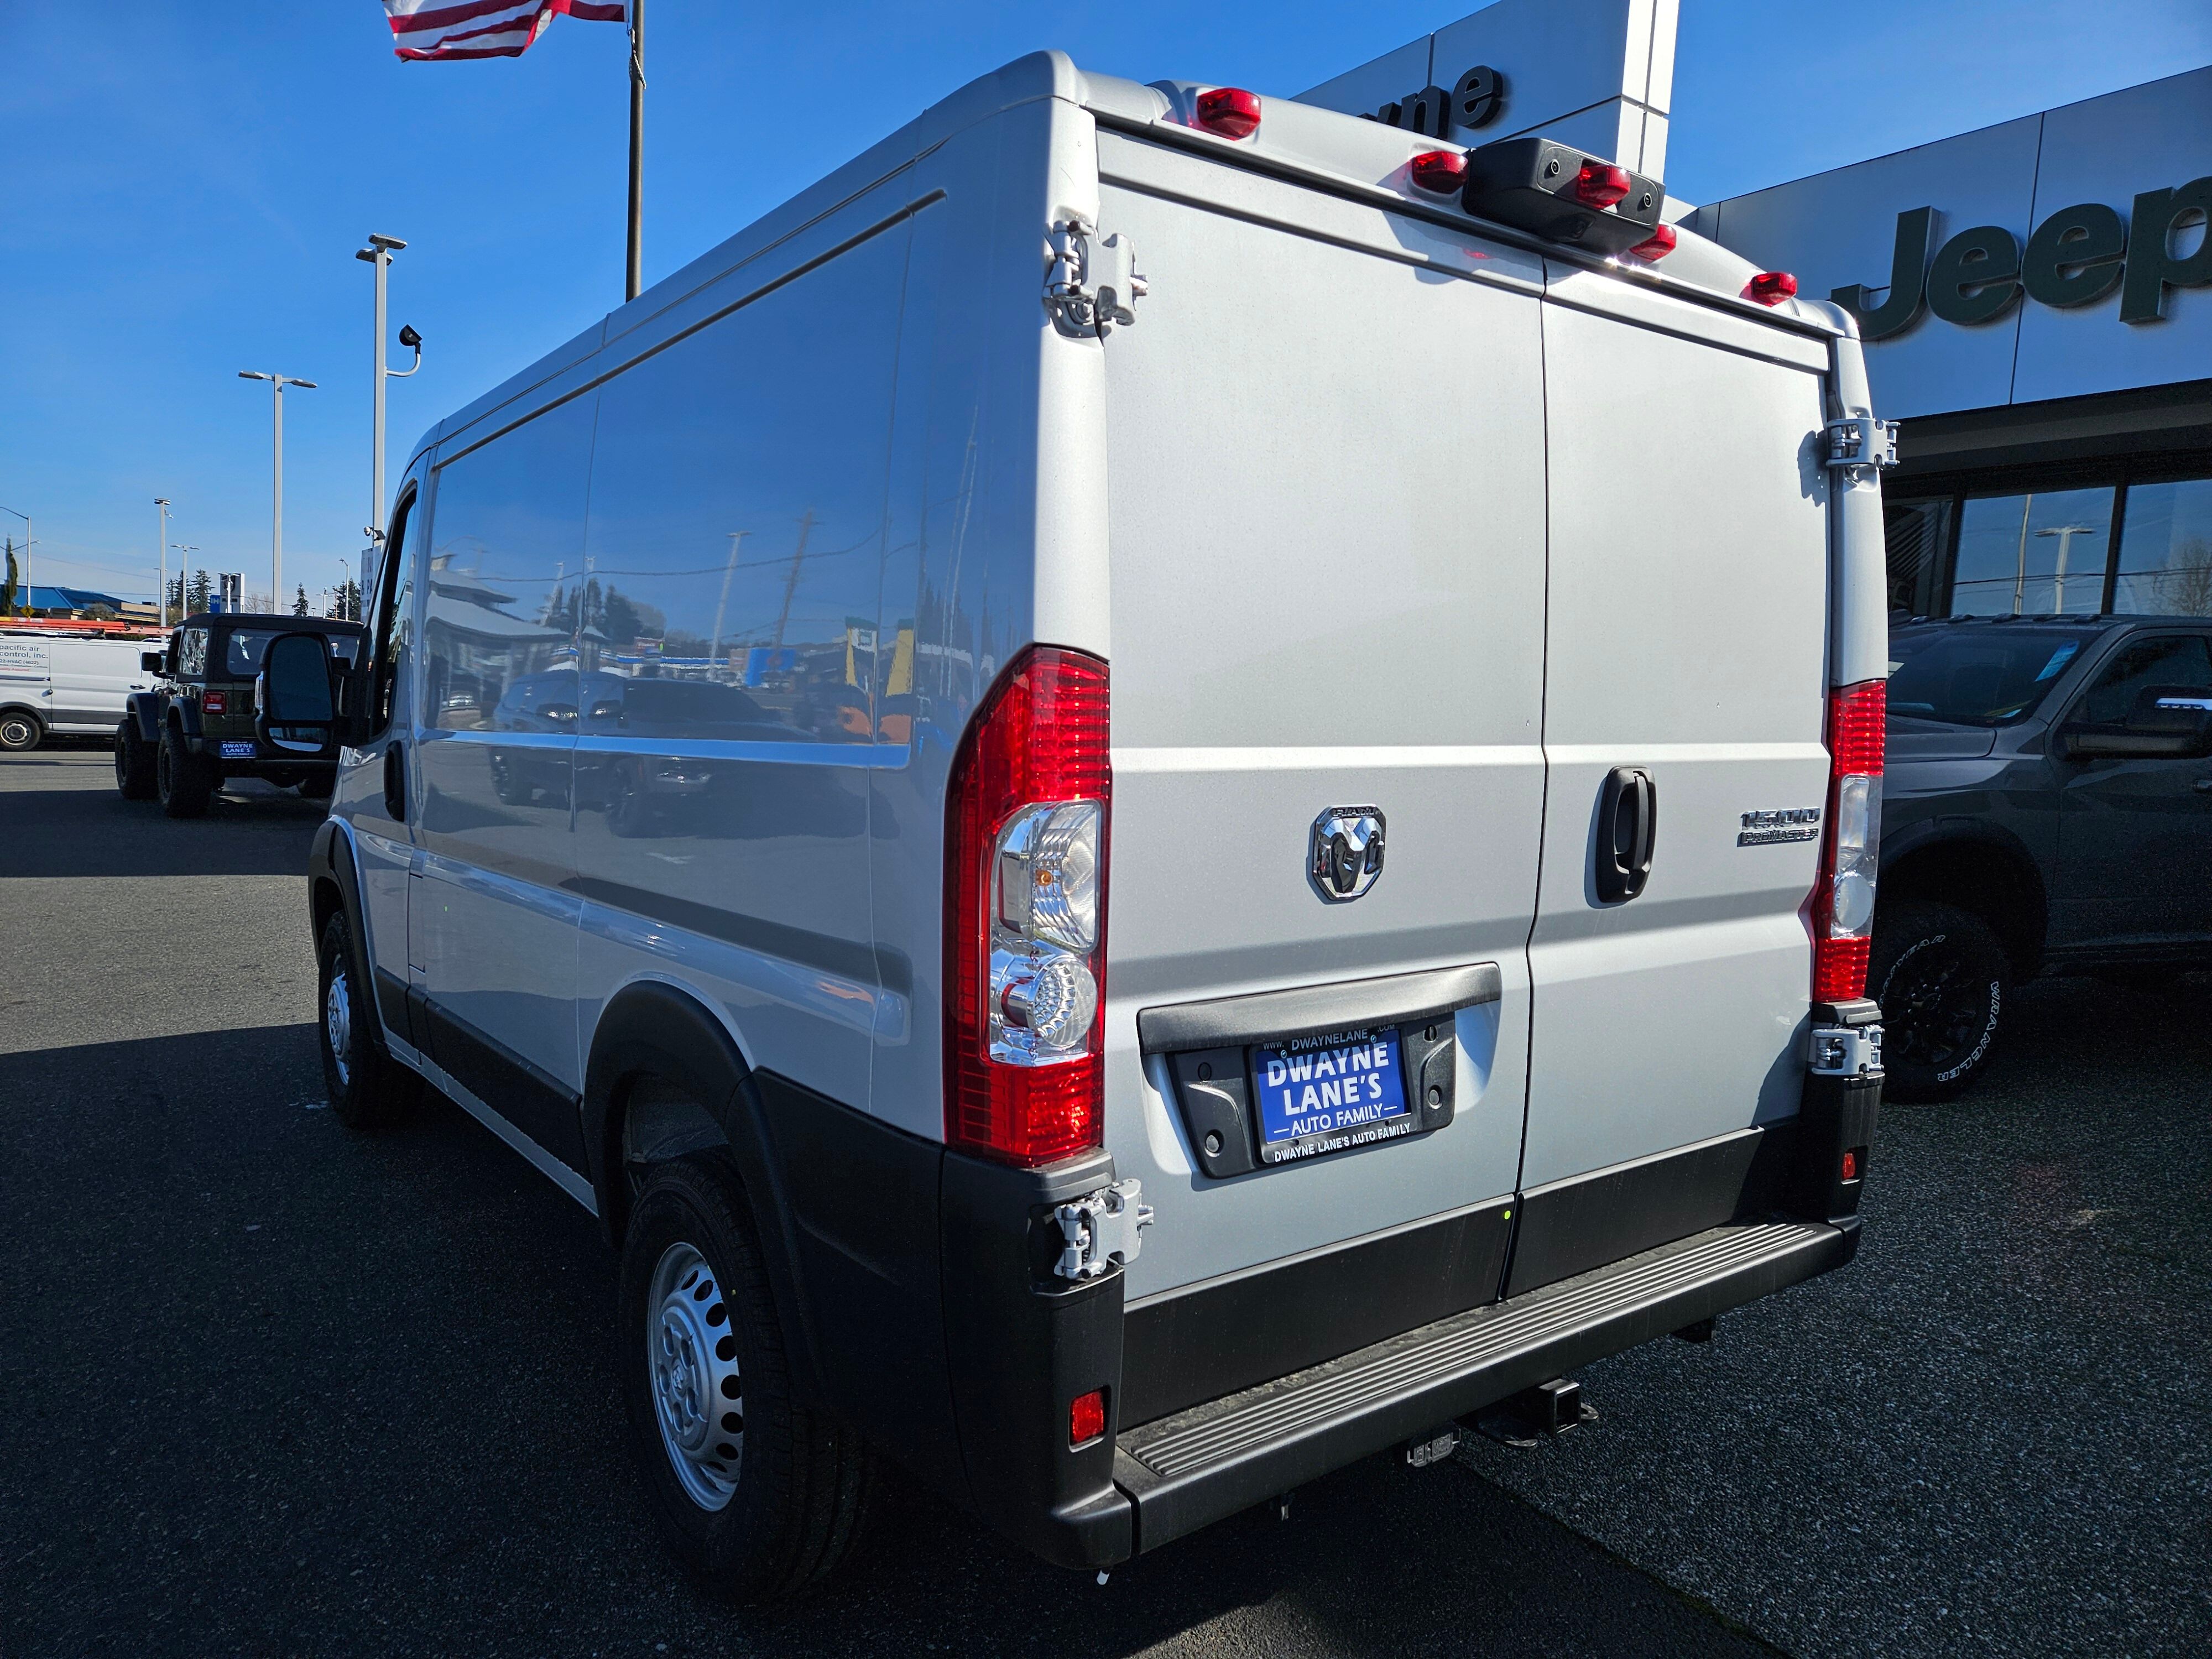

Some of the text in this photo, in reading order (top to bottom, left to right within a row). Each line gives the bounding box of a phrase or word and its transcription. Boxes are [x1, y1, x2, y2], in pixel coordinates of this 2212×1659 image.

[1830, 176, 2212, 342] Jeep
[1333, 807, 1375, 817] RAM
[1740, 806, 1820, 830] 1500
[1263, 1041, 1285, 1050] WWW.
[1291, 1029, 1368, 1051] DWAYNELANE
[1938, 981, 2000, 1082] WRANGLER
[1267, 1042, 1389, 1087] DWAYNE
[1284, 1072, 1383, 1116] LANE'S
[1291, 1103, 1383, 1136] AUTO FAMILY
[1274, 1122, 1411, 1162] DWAYNE LANE'S AUTO FAMILY
